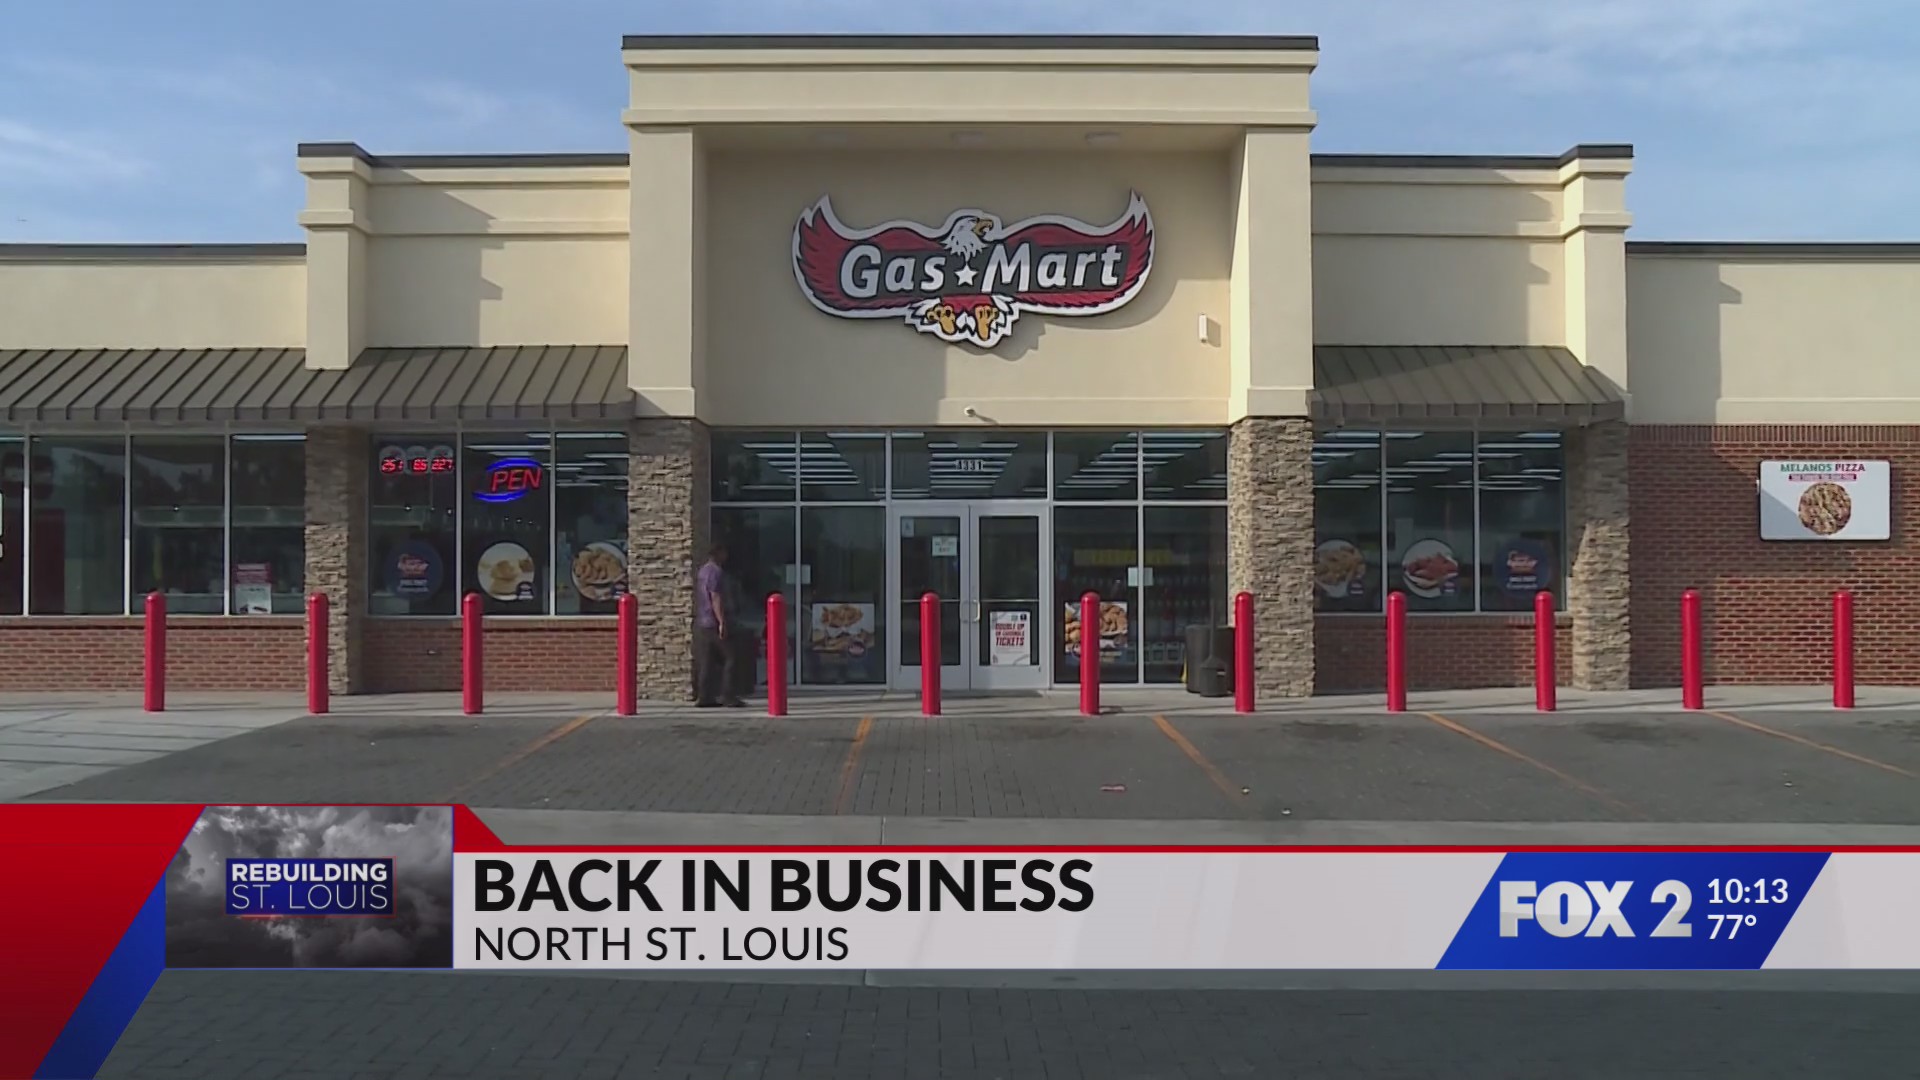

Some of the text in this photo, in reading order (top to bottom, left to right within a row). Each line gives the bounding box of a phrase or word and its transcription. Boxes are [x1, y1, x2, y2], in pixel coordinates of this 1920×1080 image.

[840, 242, 1121, 298] Gas Mart
[1835, 463, 1866, 472] PIZZA
[995, 637, 1025, 646] TICKETS
